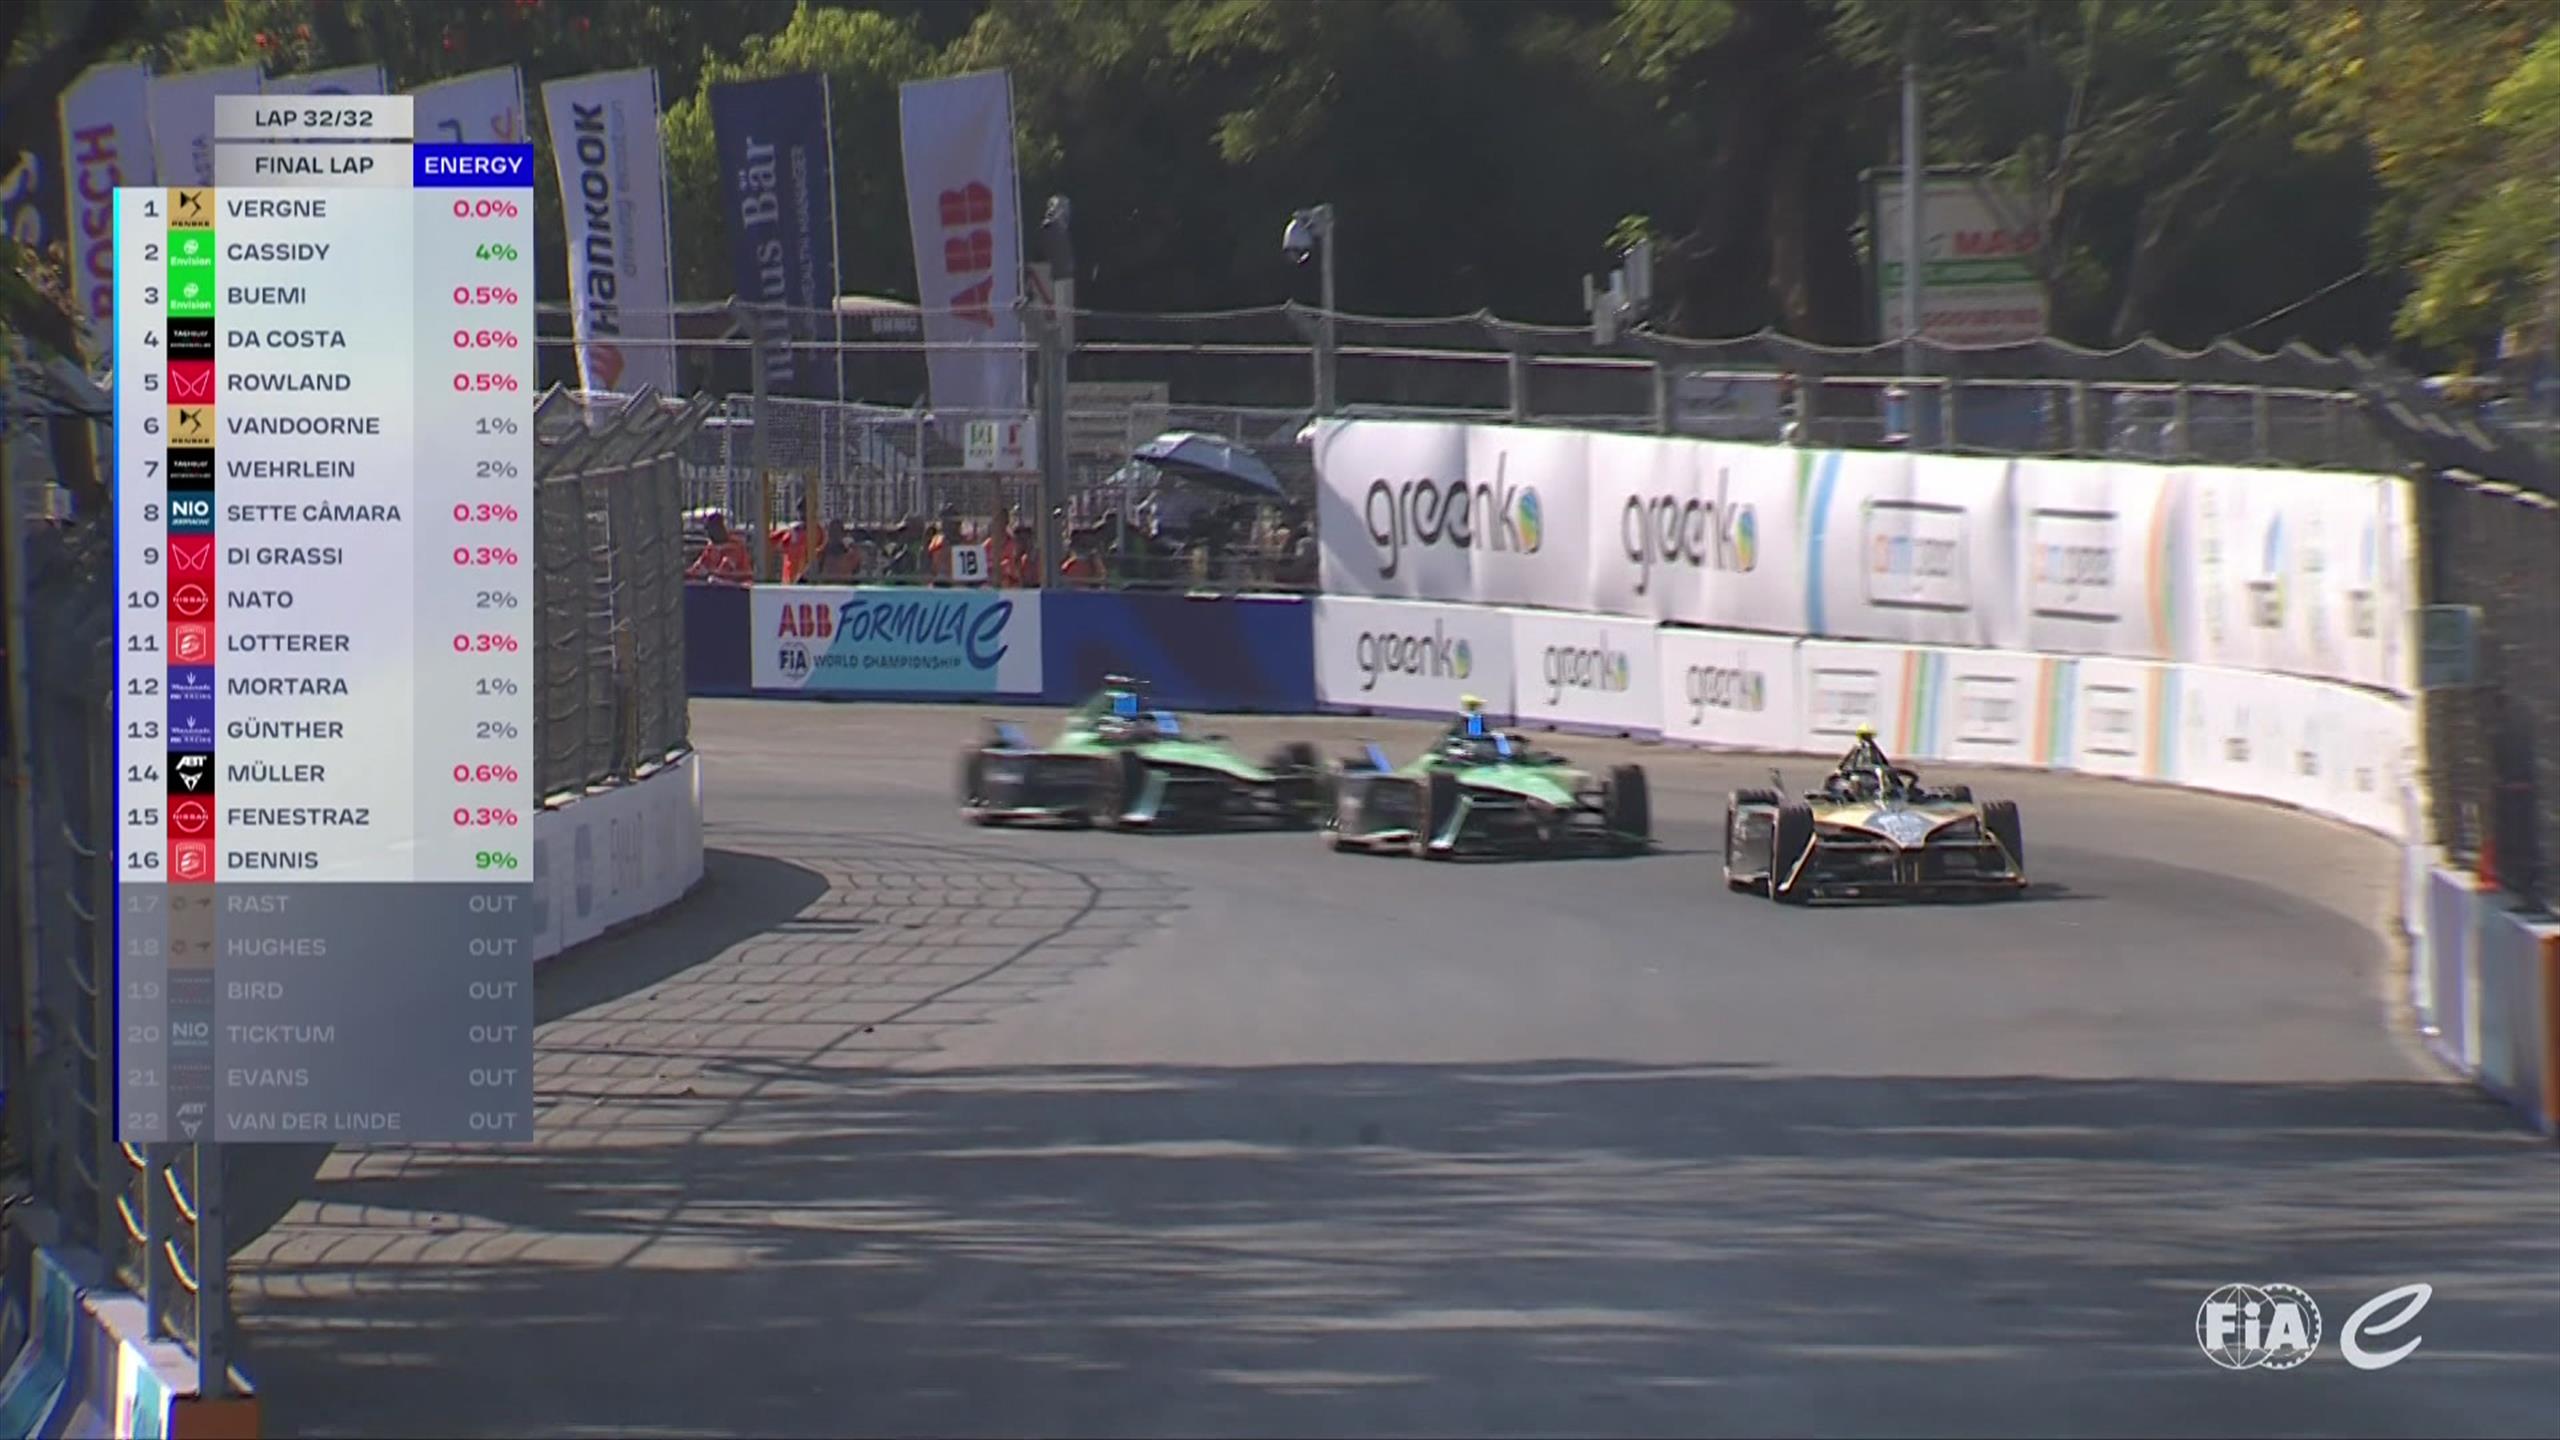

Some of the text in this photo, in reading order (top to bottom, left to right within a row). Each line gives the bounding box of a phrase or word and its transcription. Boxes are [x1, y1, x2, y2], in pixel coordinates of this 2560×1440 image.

[738, 134, 780, 229] Bär
[938, 180, 994, 330] ABB
[958, 550, 979, 576] 18
[777, 603, 833, 639] ABB
[834, 599, 969, 646] FORMULA
[813, 655, 962, 670] WORLD CHAMPIONSHIP
